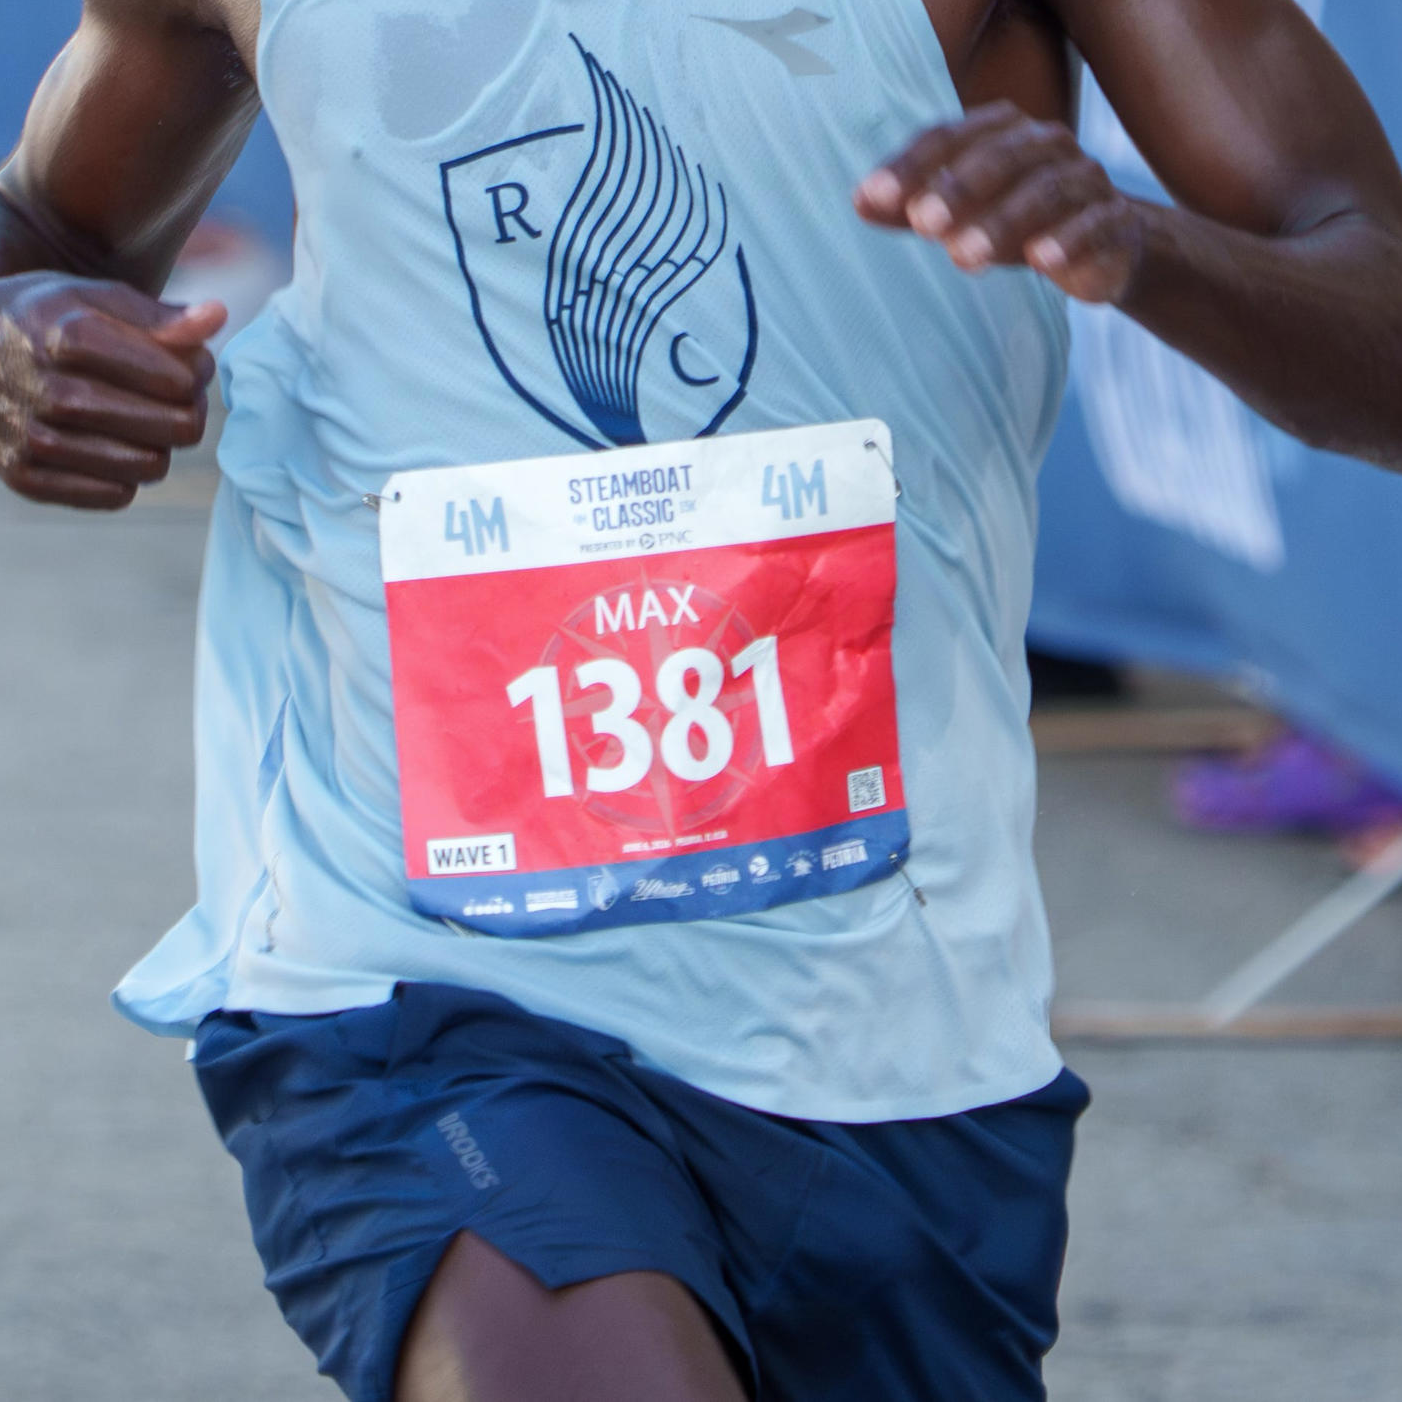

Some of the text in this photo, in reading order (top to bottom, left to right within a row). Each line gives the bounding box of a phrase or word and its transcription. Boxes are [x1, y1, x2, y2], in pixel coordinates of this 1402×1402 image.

[485, 182, 542, 244] R
[670, 331, 720, 386] C
[569, 464, 693, 505] STEAMBOAT
[761, 458, 828, 520] 4M
[444, 496, 510, 556] 4M
[592, 498, 674, 532] CLASSIC
[658, 529, 693, 547] PNC
[595, 584, 700, 635] MAX
[506, 635, 794, 798] 1381
[434, 844, 508, 868] WAVE 1
